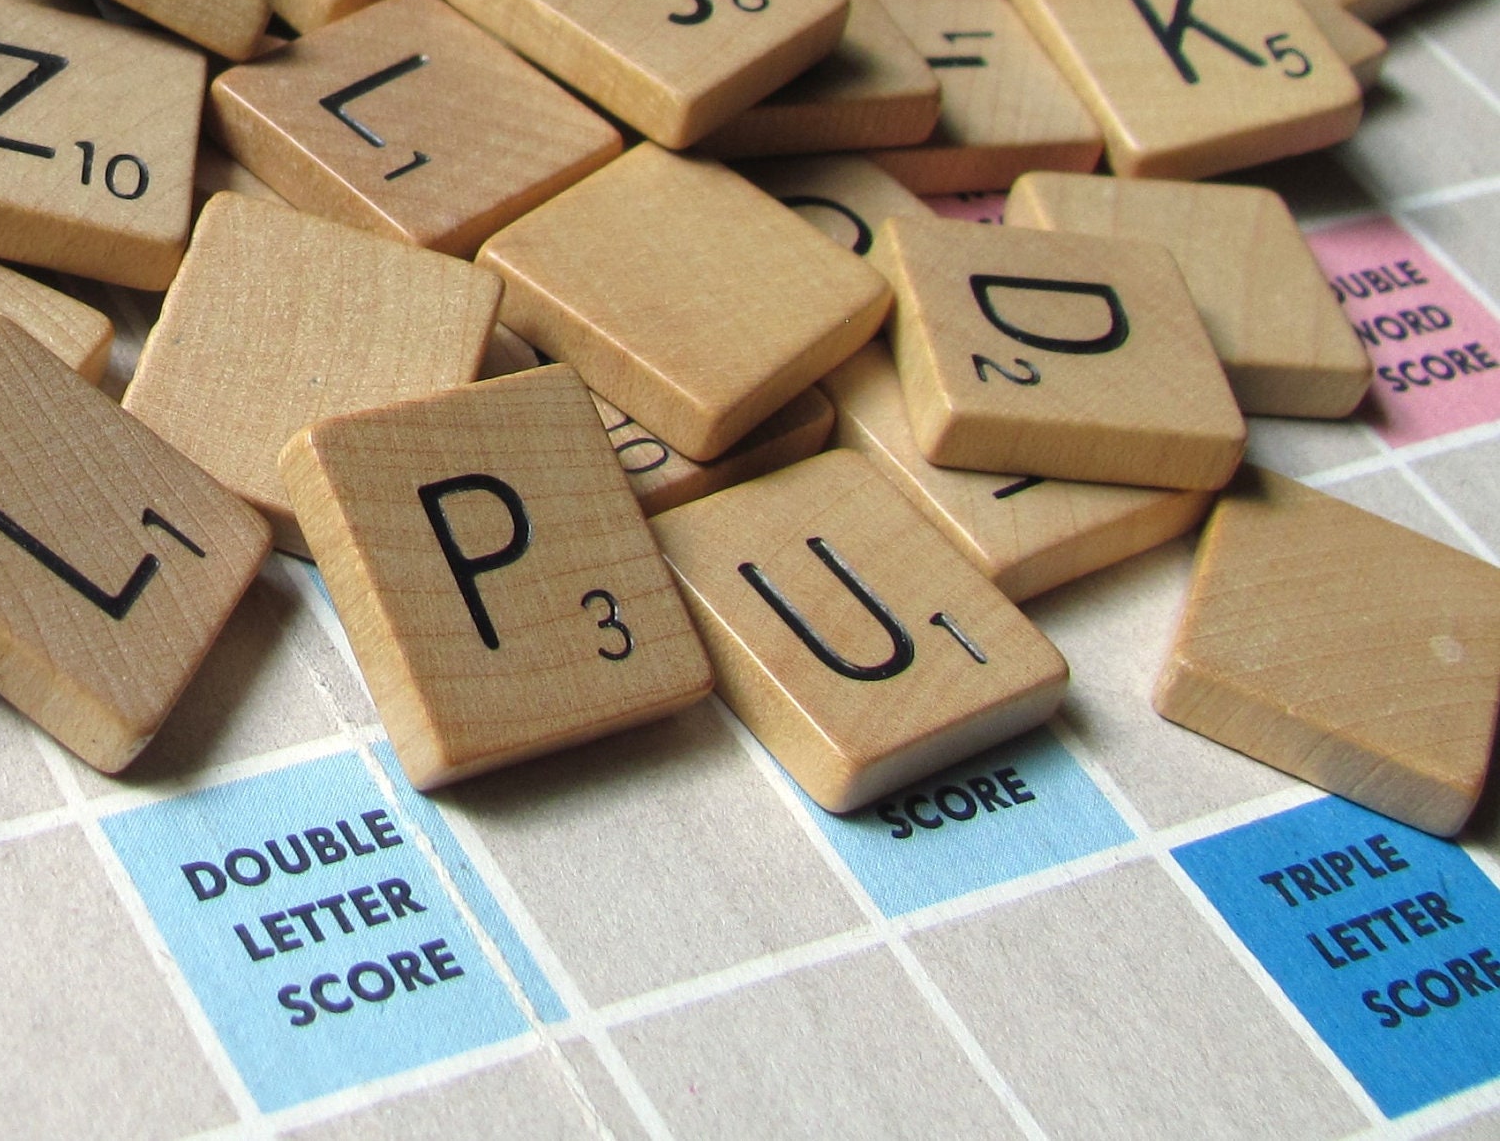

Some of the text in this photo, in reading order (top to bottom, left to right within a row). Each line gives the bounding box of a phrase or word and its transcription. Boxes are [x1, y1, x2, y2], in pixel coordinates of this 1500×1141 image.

[969, 274, 1131, 355] D
[1329, 260, 1429, 304] UBLE
[1376, 342, 1500, 393] SCORE
[418, 473, 534, 652] P
[737, 536, 916, 682] U
[876, 766, 1037, 841] SCORE
[180, 808, 404, 902] DOUBLE
[1260, 833, 1411, 908] TRIPLE
[233, 877, 427, 962] LETTER
[1306, 890, 1466, 970] LETTER
[276, 938, 465, 1028] SCORE
